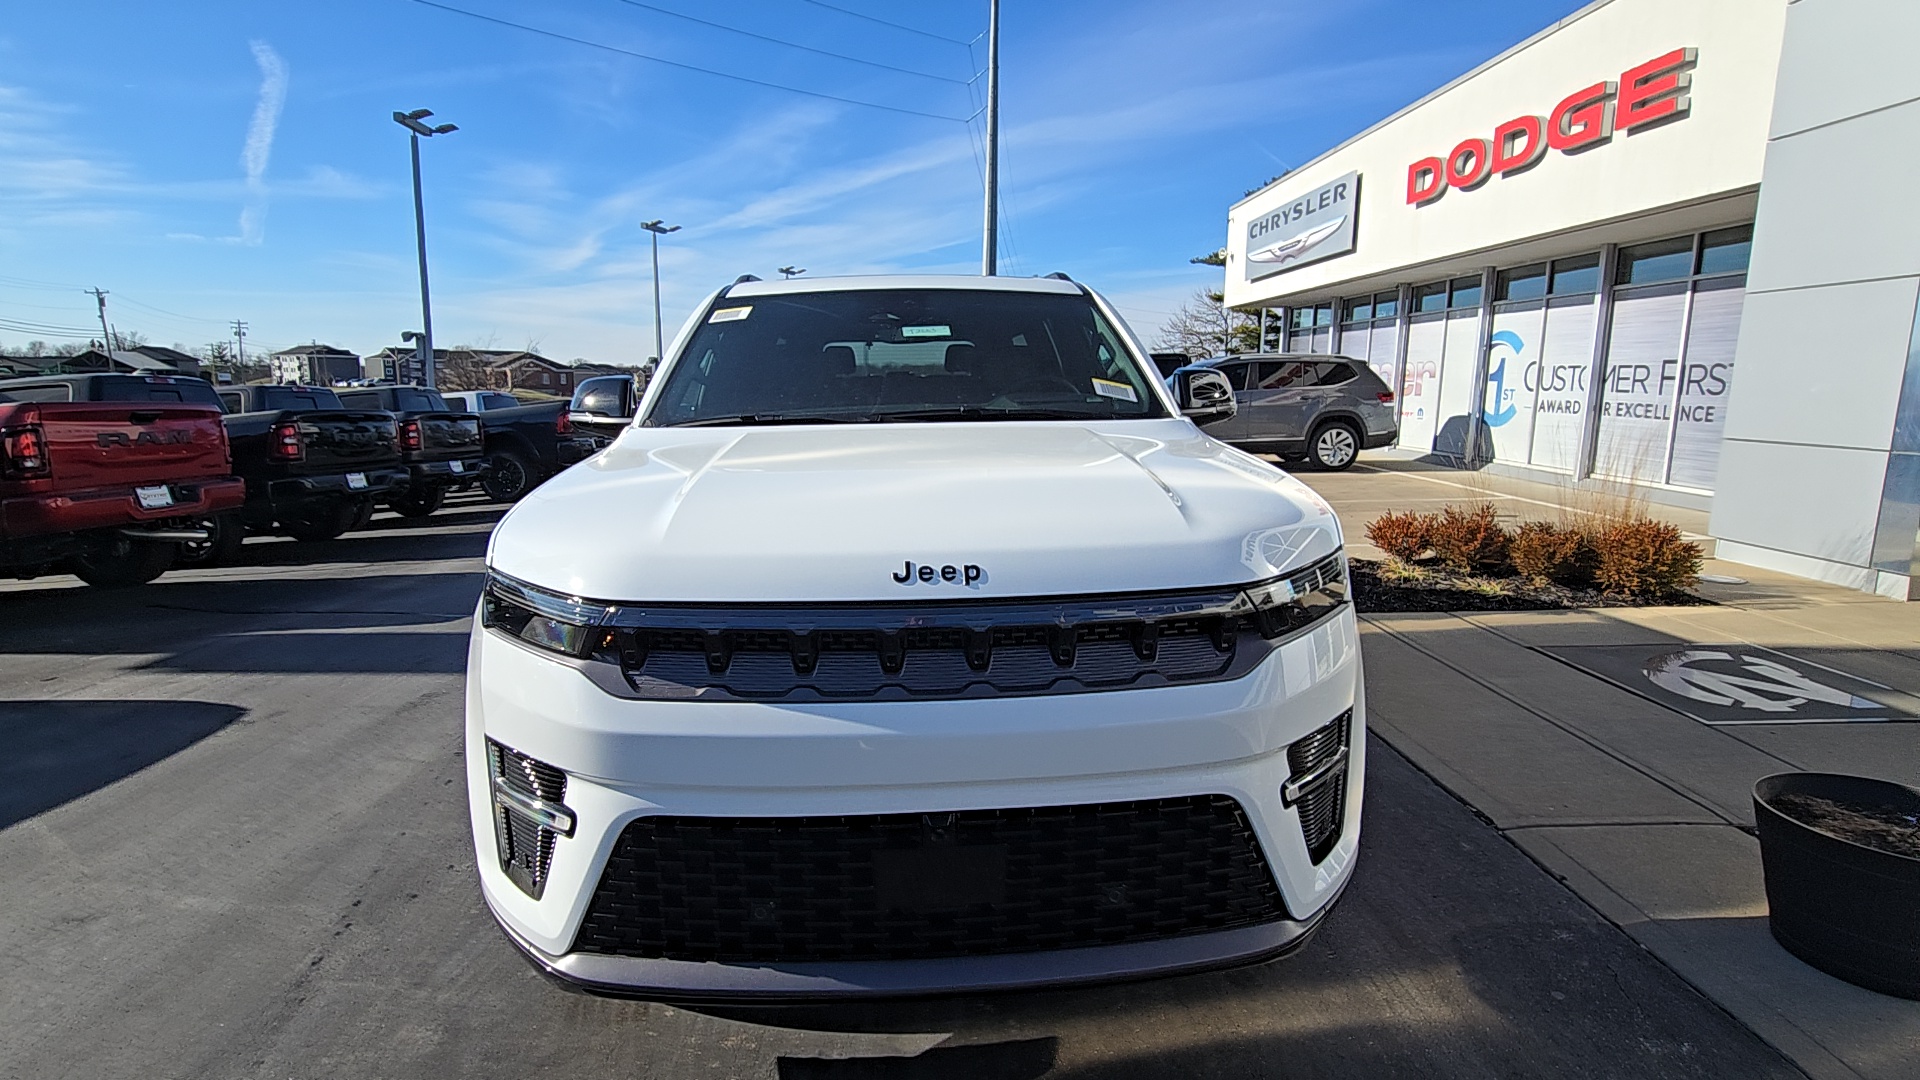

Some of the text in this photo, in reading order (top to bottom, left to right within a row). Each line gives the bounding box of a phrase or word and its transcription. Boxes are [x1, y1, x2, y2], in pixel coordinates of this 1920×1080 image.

[1407, 47, 1697, 206] DODGE
[1249, 182, 1347, 240] CHRYSLER
[1658, 359, 1735, 396] FIRS
[1538, 399, 1581, 415] AWARD
[1616, 401, 1716, 423] EXCELLNCE
[97, 429, 193, 448] RAM
[891, 560, 984, 587] Jeep
